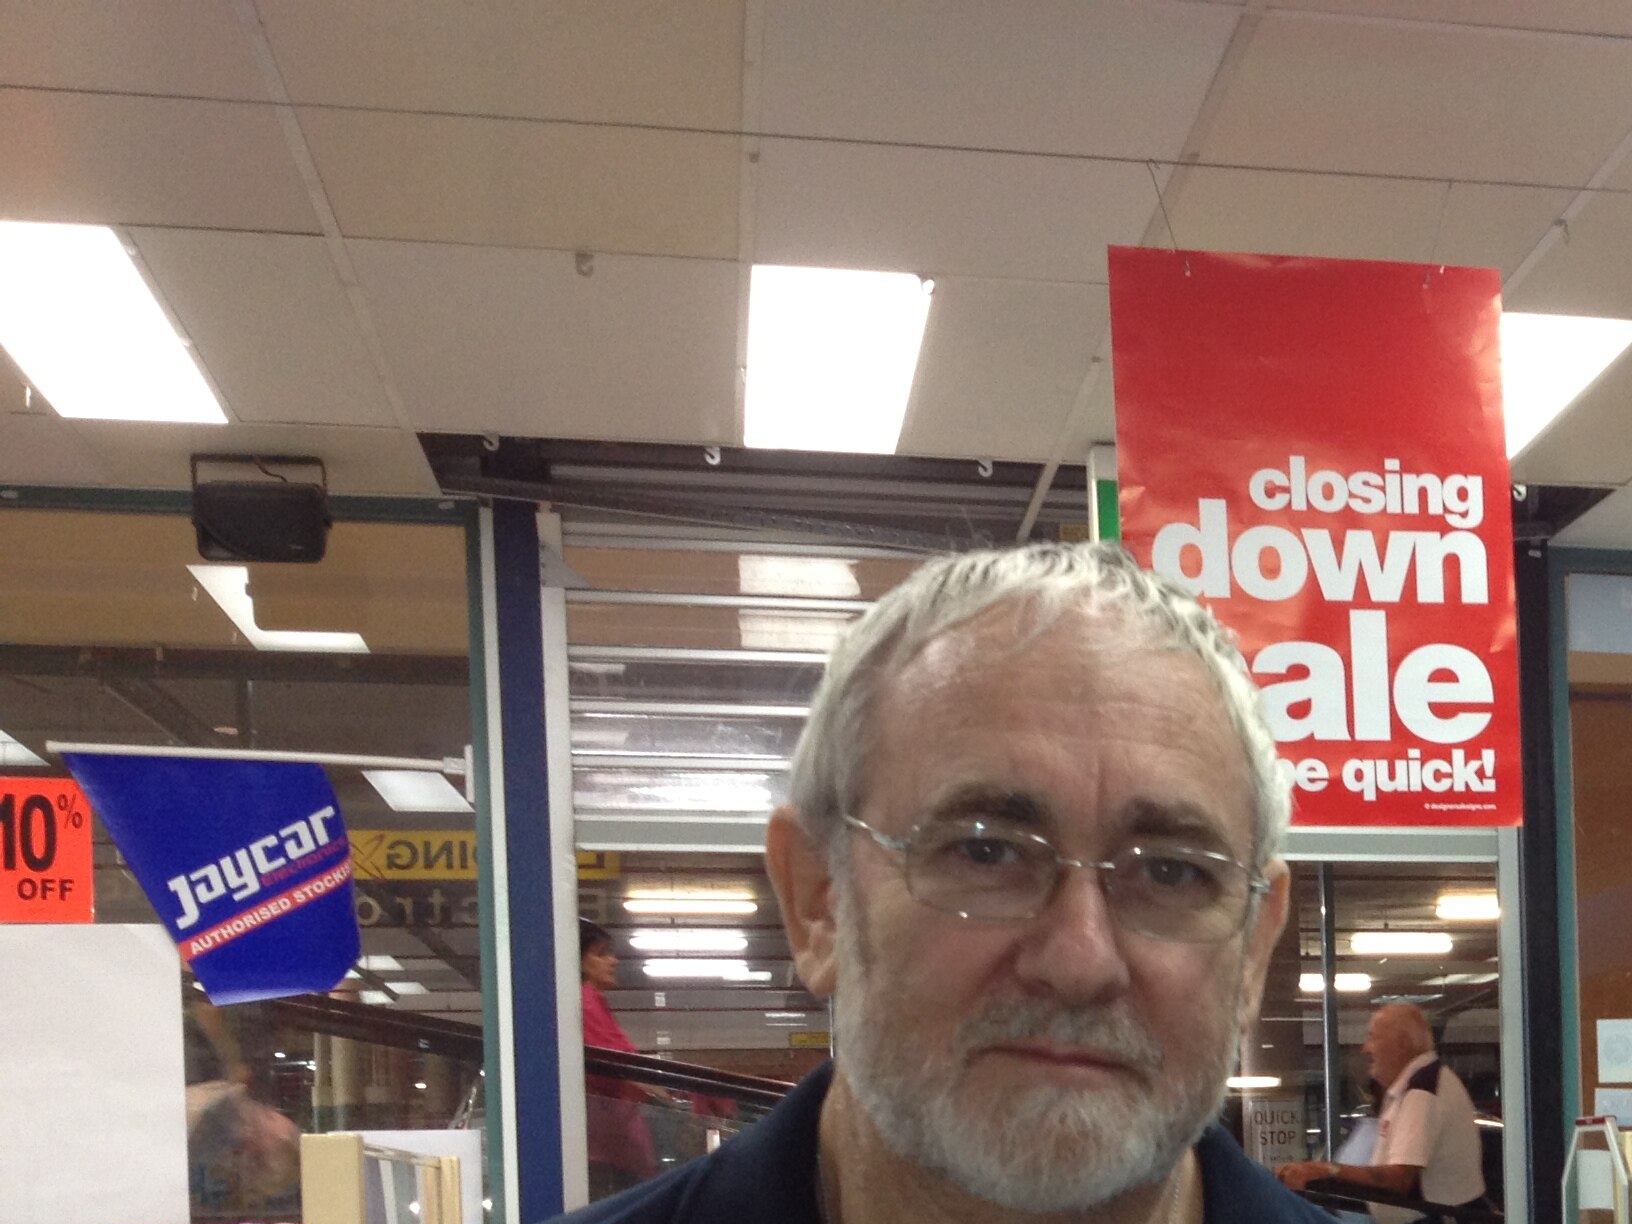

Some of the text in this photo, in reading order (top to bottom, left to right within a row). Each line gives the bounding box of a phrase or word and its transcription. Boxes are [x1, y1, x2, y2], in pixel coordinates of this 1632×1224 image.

[1249, 456, 1485, 528] closing
[1152, 498, 1489, 604] down
[1248, 609, 1495, 744] ale
[1342, 748, 1497, 801] quick!
[17, 878, 75, 901] OFF
[166, 805, 336, 931] Jaycar
[190, 860, 353, 956] AUTHORISED STOCKIS
[1254, 1110, 1300, 1125] QUICK
[1260, 1131, 1296, 1146] STOP
